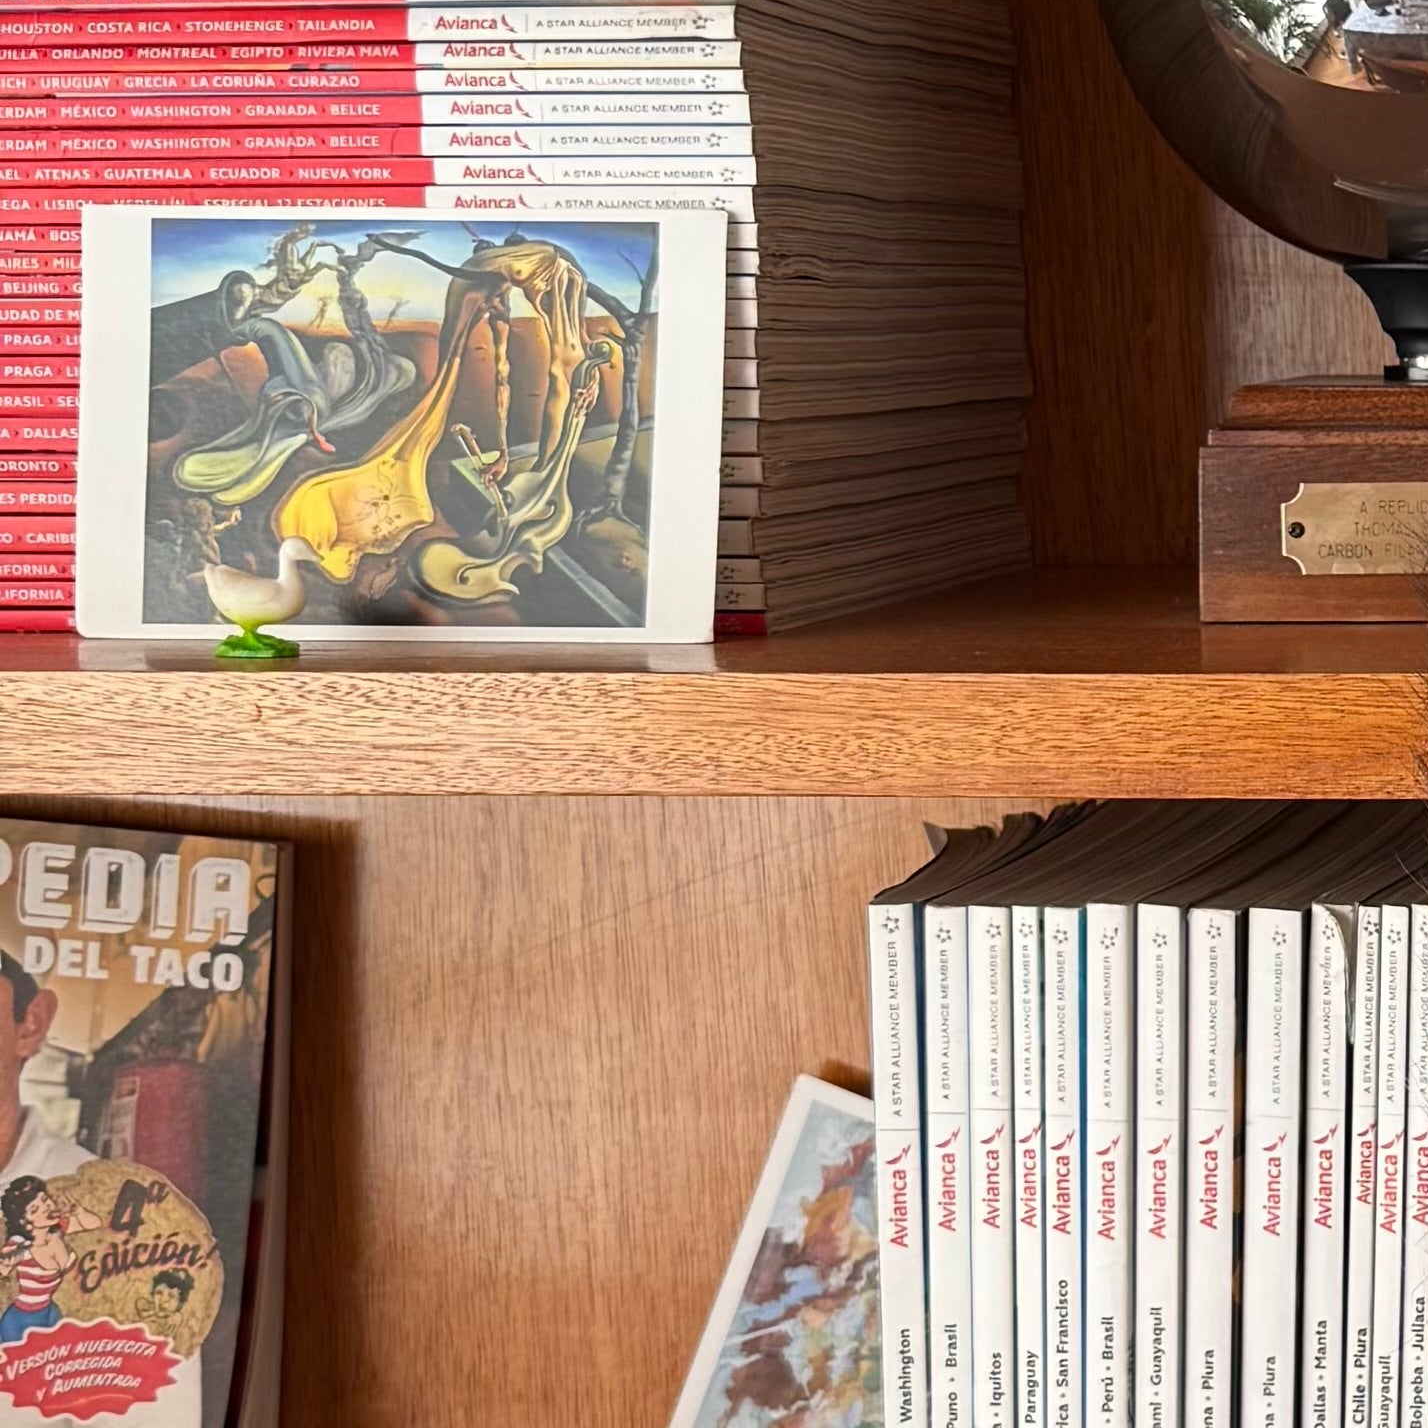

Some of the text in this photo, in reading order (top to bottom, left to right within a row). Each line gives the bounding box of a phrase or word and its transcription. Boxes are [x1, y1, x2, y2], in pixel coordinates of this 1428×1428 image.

[297, 18, 375, 32] TAILANDIA
[130, 104, 232, 118] WASHINGTON
[1318, 544, 1374, 560] CARBON
[23, 936, 245, 992] DEL TACO
[889, 1168, 909, 1249] Avianca
[899, 1328, 913, 1423] Washington
